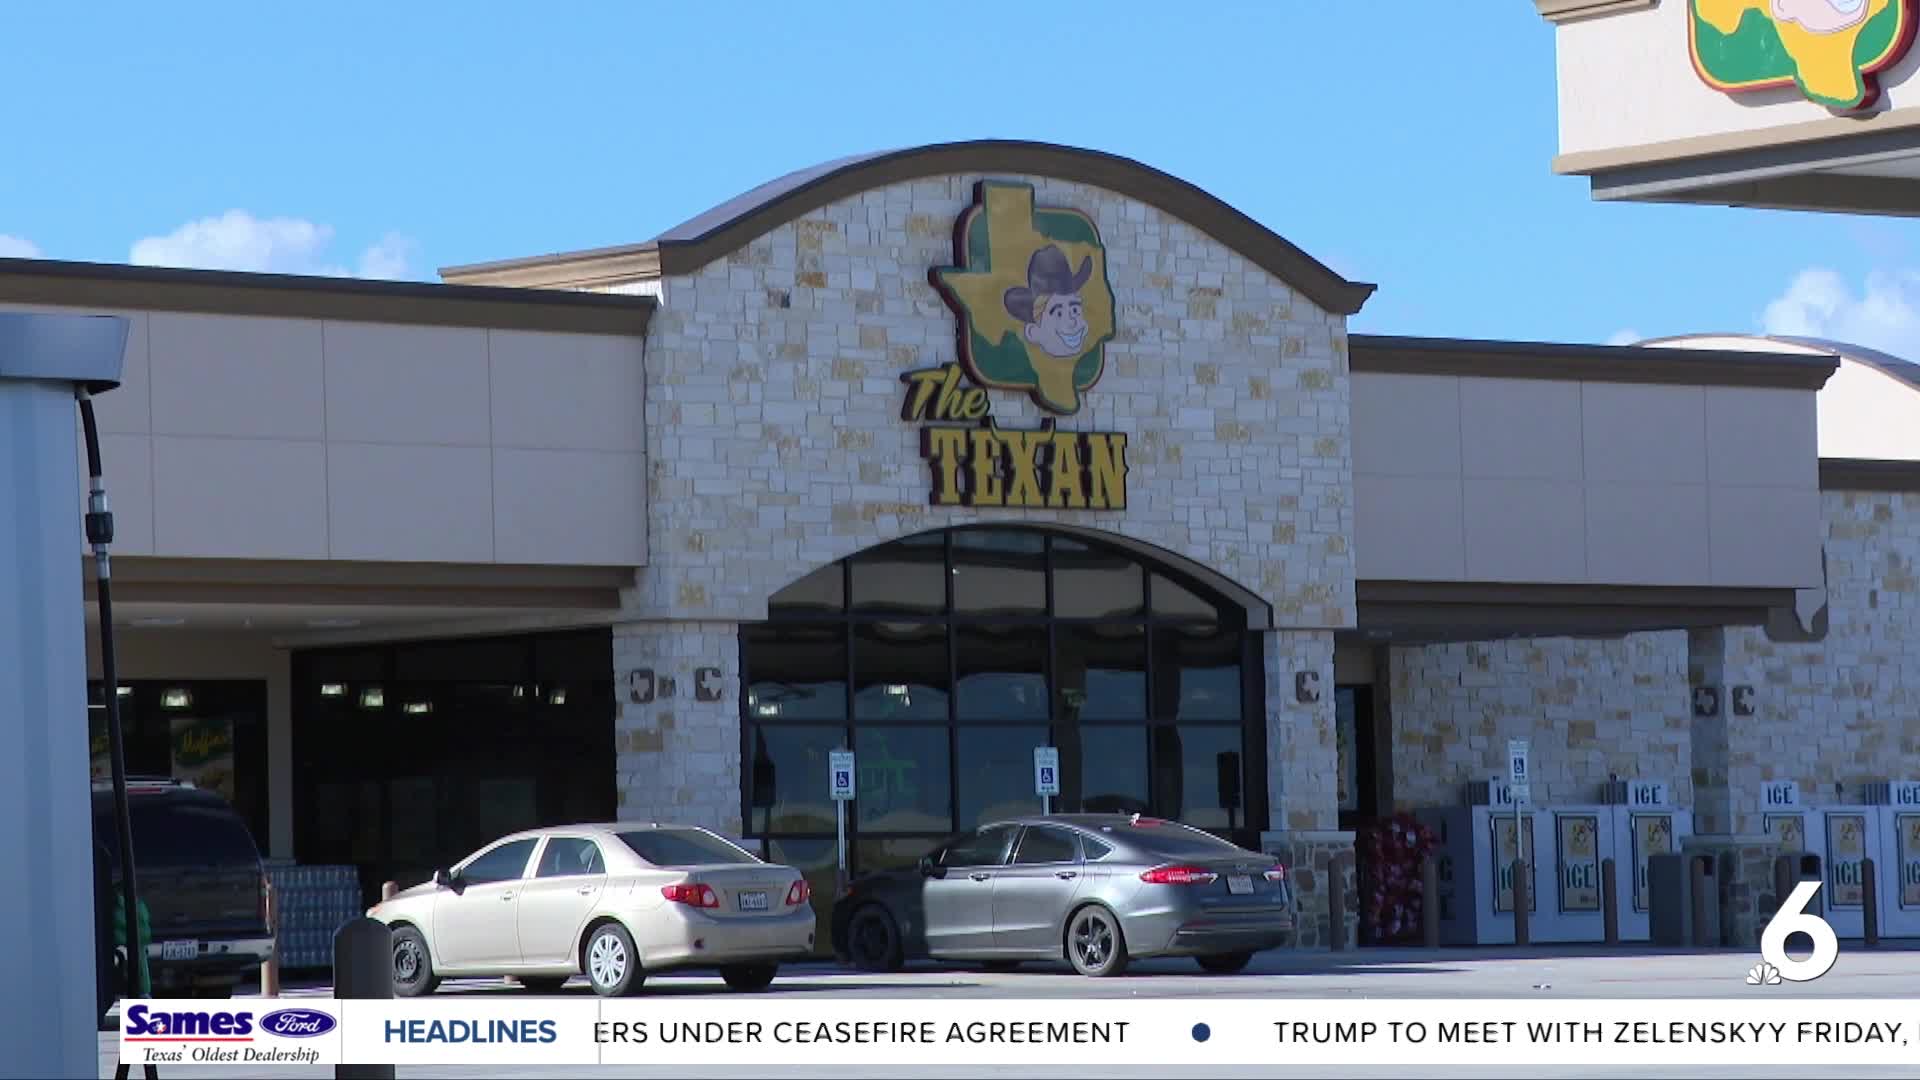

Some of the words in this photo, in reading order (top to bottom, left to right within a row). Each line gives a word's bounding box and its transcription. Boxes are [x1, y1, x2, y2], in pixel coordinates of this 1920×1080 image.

[901, 361, 990, 422] The
[921, 420, 1128, 510] TEXAN
[1635, 785, 1661, 804] ICE
[1767, 785, 1793, 804] ICE
[1567, 863, 1595, 889] ICE
[1835, 861, 1862, 885] ICE
